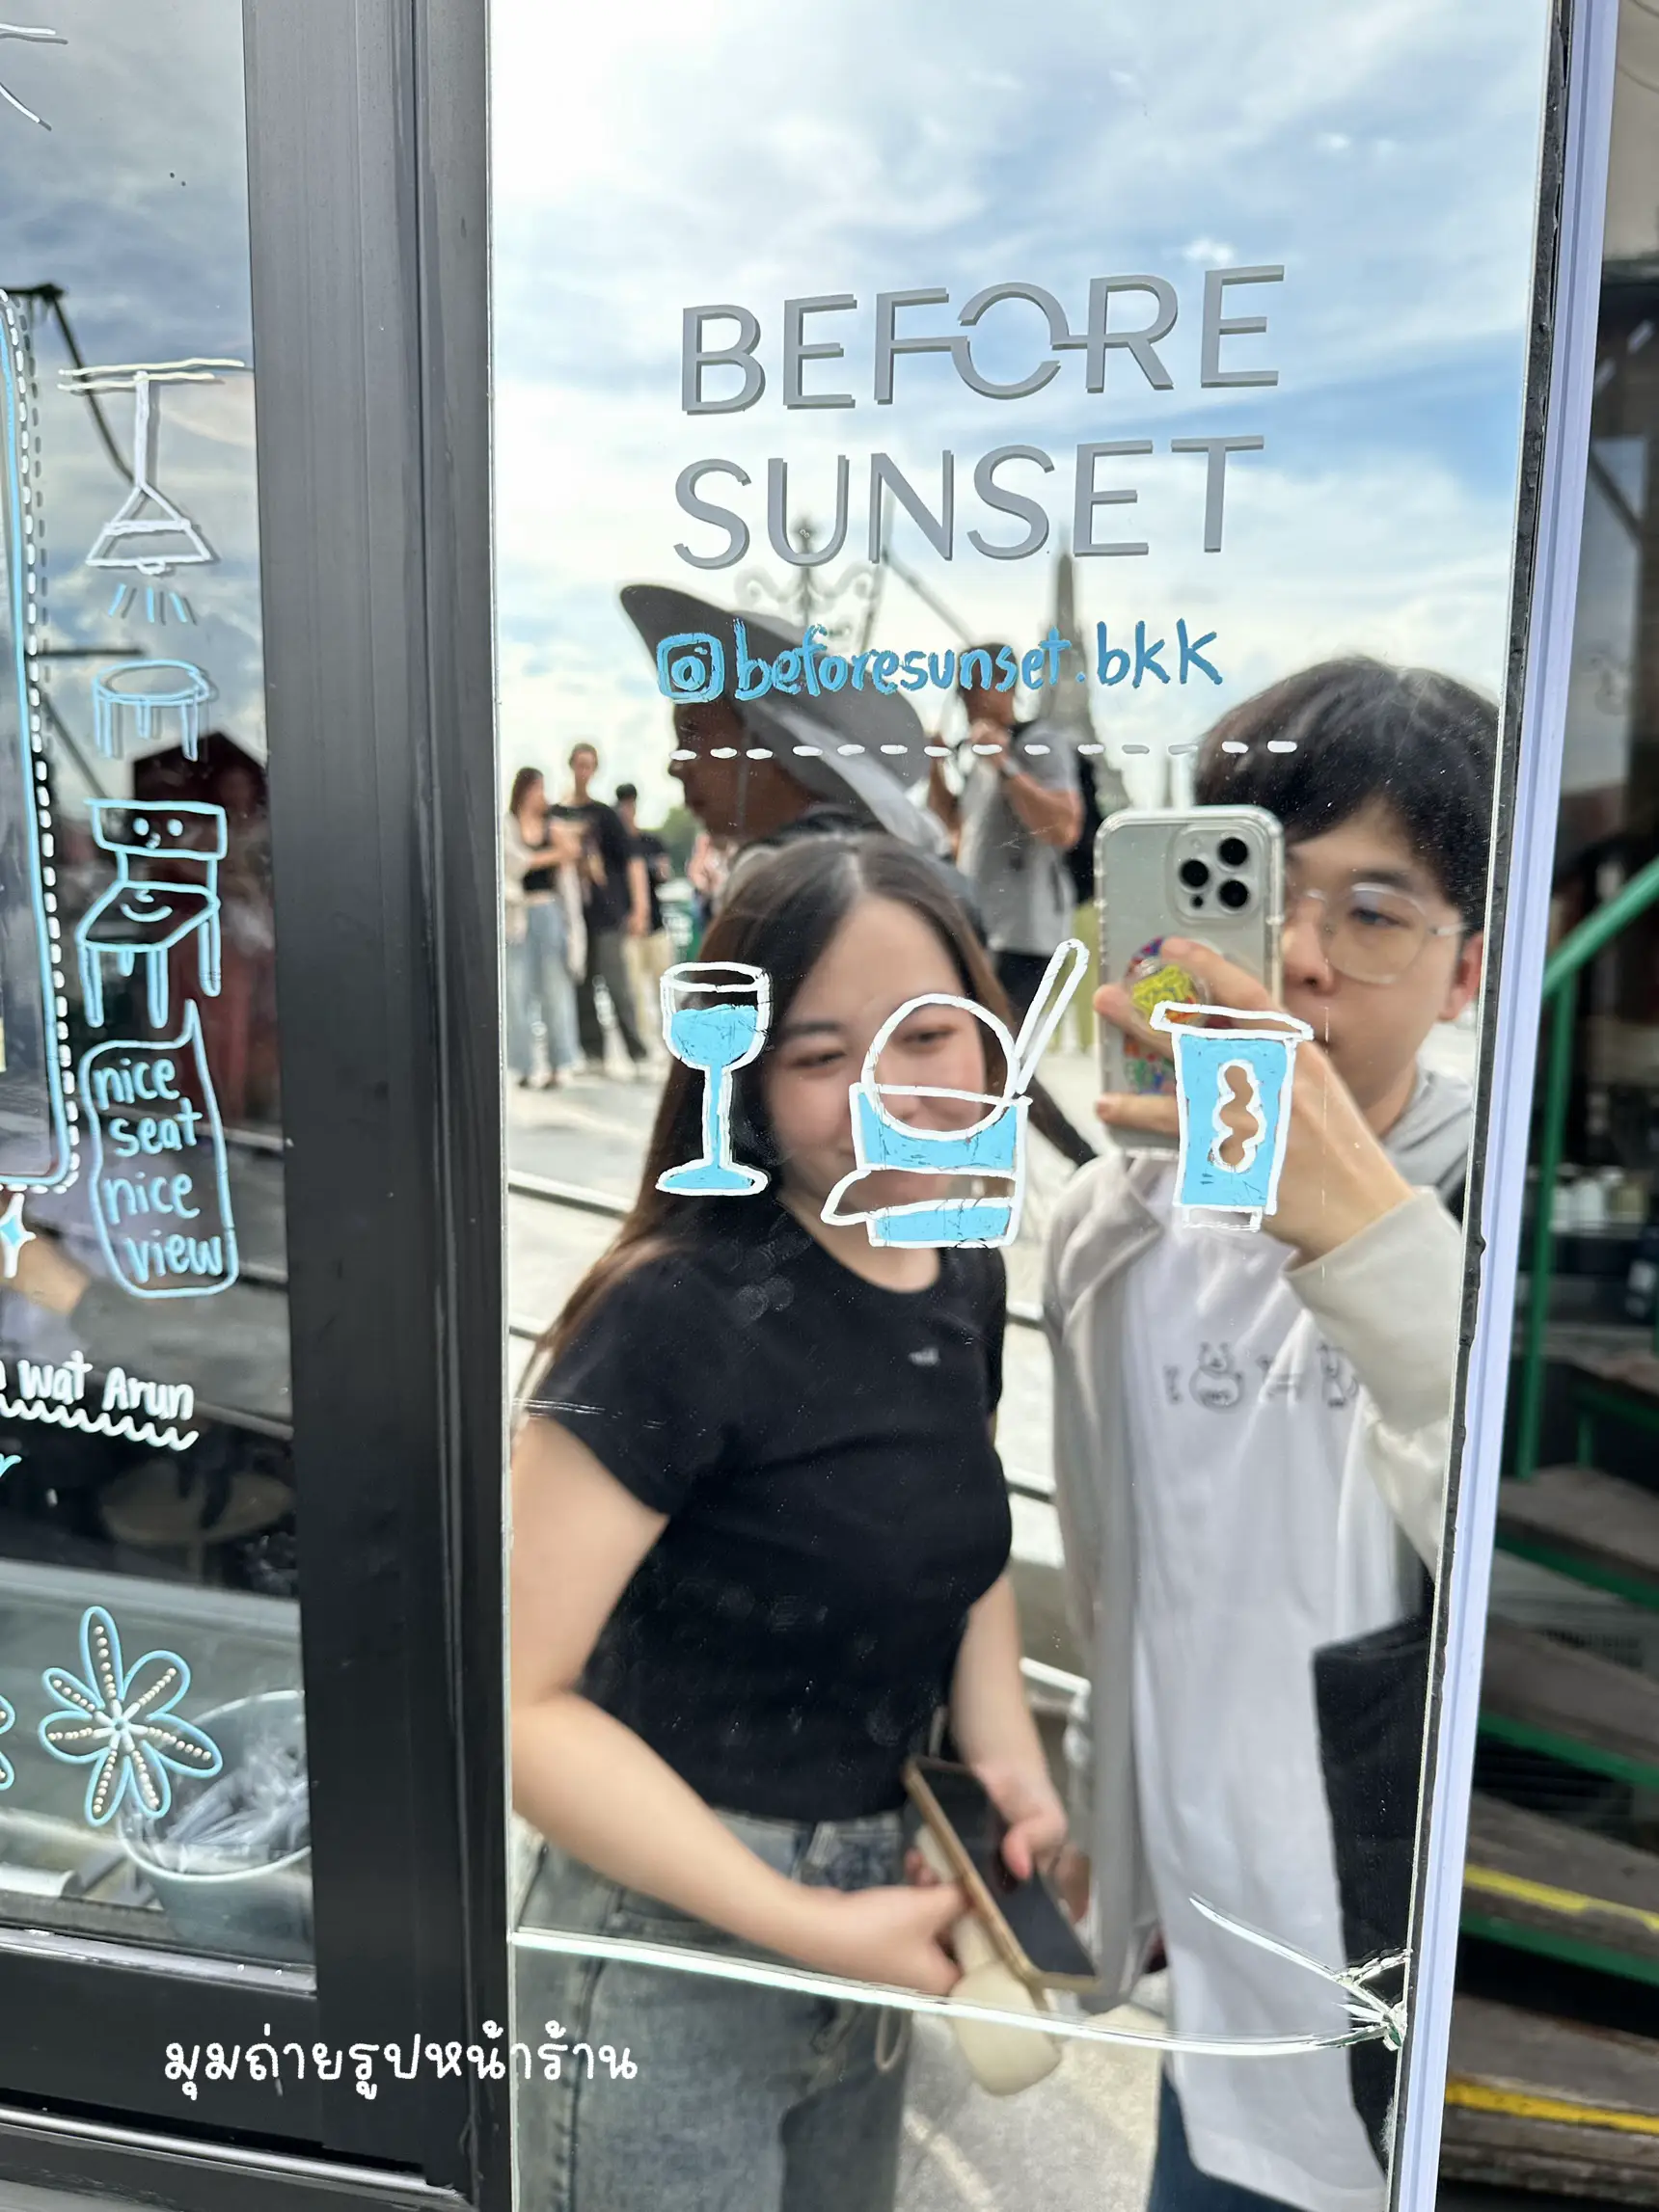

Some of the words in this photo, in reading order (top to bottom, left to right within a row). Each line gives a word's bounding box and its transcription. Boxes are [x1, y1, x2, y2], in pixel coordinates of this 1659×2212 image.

[681, 265, 1285, 416] BEFORE
[673, 435, 1265, 570] SUNSET
[93, 1057, 180, 1110] nice
[108, 1096, 203, 1157] seat
[102, 1172, 201, 1225] nice
[122, 1228, 224, 1284] view
[101, 1366, 195, 1420] Arun
